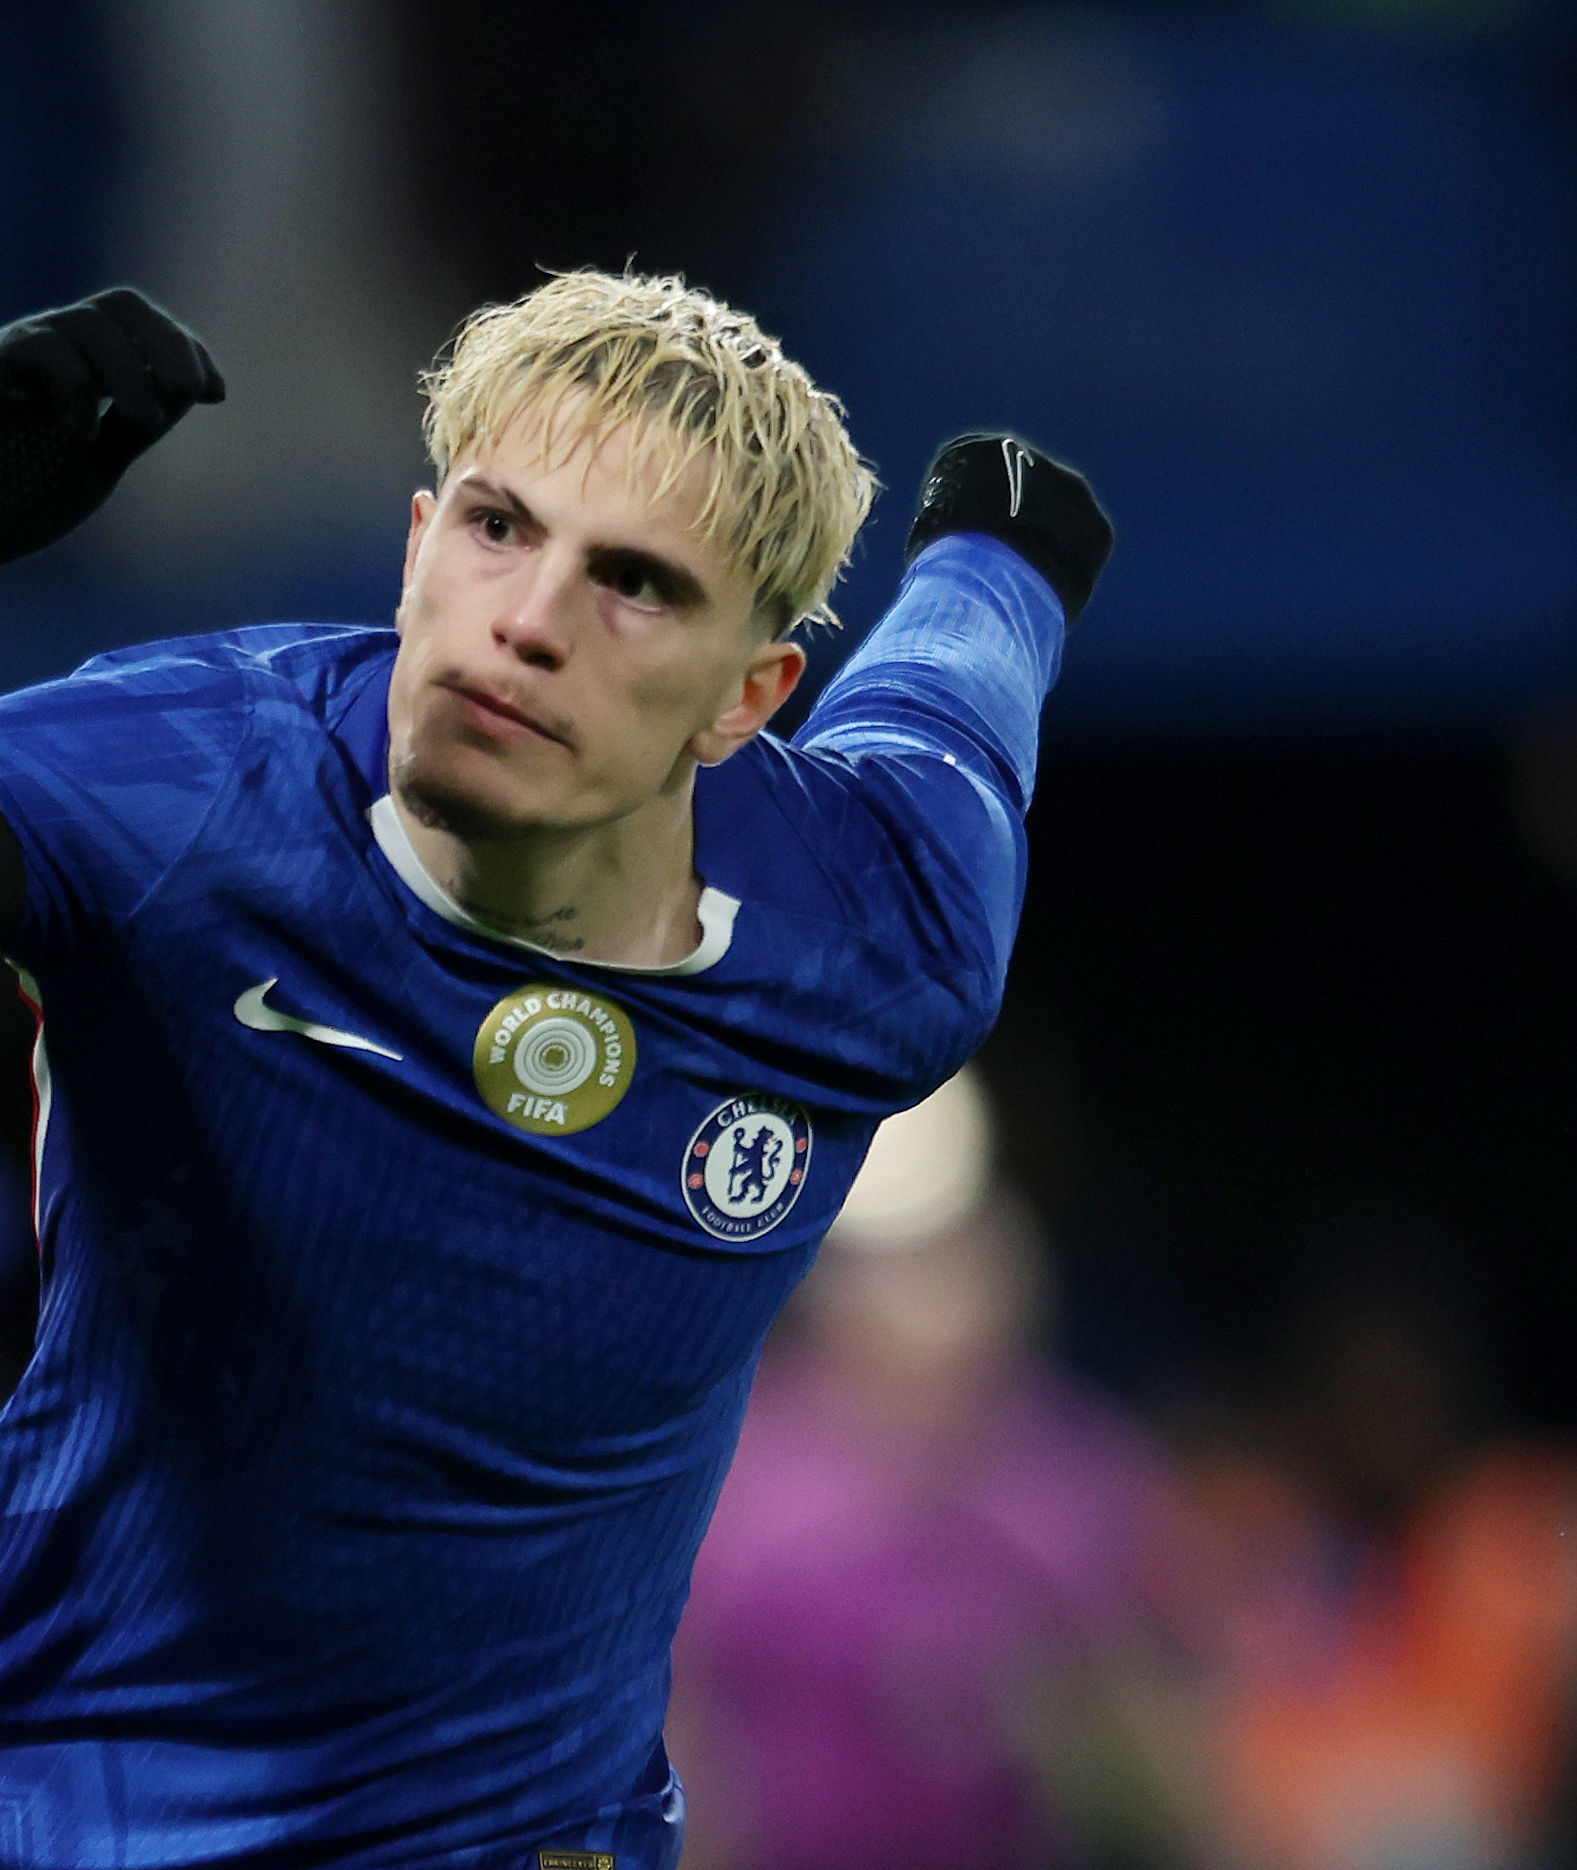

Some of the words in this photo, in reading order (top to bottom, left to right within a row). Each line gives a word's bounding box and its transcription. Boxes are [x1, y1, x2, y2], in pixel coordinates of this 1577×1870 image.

[489, 995, 542, 1063] WORLD
[546, 991, 622, 1087] CHAMPIONS
[507, 1093, 568, 1125] FIFA
